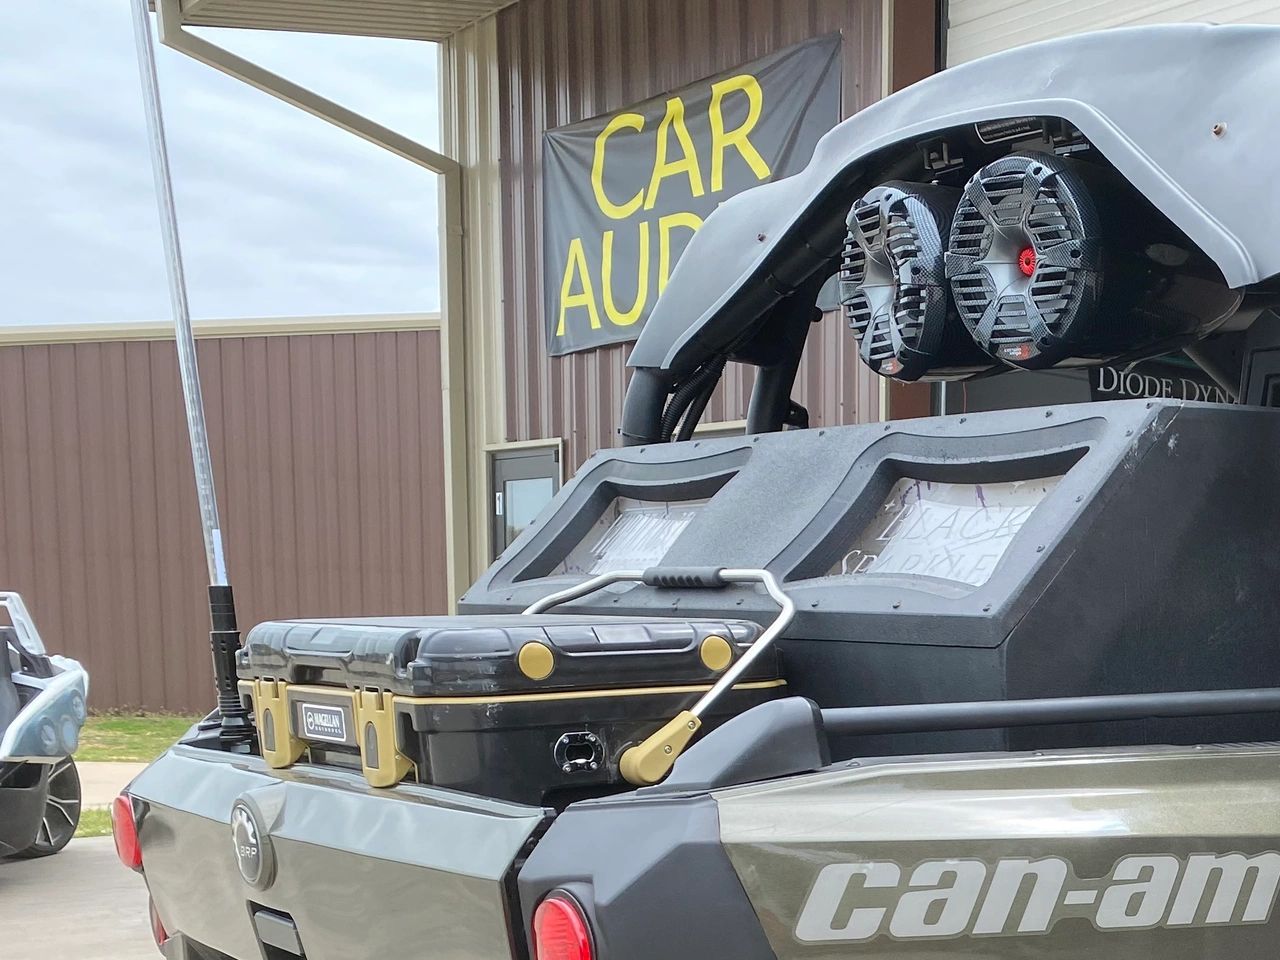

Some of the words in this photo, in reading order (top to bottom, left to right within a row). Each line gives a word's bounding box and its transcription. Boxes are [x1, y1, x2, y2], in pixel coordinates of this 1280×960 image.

[591, 74, 771, 219] CAR
[1097, 366, 1175, 398] DIODE
[240, 845, 257, 858] BRP
